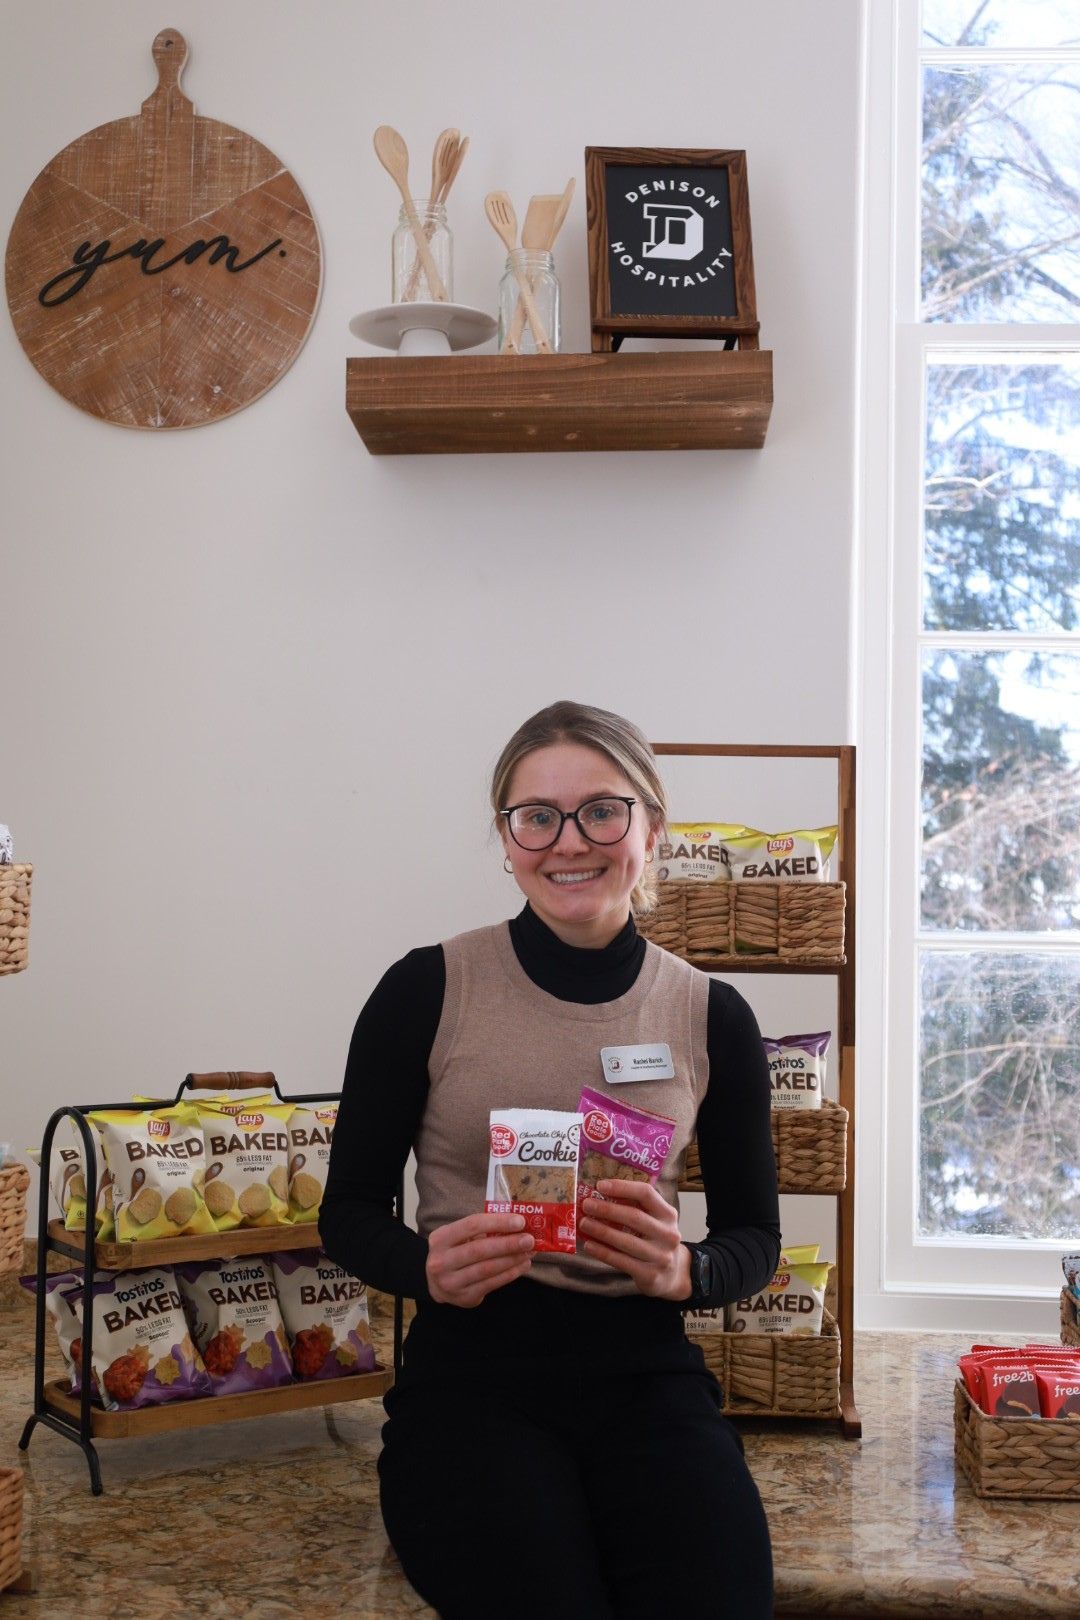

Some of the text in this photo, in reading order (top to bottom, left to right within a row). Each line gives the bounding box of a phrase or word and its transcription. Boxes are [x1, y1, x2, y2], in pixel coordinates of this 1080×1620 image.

[625, 180, 720, 208] DENISON
[611, 241, 733, 287] HOSPITALITY
[742, 856, 819, 878] BAKED
[768, 1057, 805, 1071] ostitos
[770, 1072, 818, 1091] KED
[591, 1115, 609, 1128] Red
[210, 1133, 288, 1155] BAKED
[291, 1127, 333, 1146] BAK
[491, 1130, 511, 1139] Red
[519, 1130, 567, 1141] Chocolate Chip
[126, 1138, 204, 1162] BAKED
[518, 1140, 578, 1162] Cookie
[610, 1138, 660, 1171] Cookie
[487, 1203, 544, 1214] FREE FROM
[208, 1282, 280, 1305] BAKED
[301, 1281, 367, 1305] BAKED
[103, 1290, 184, 1334] BAKED
[736, 1294, 815, 1314] BAKED
[148, 1319, 163, 1330] LESS
[162, 1316, 172, 1324] FAT
[993, 1371, 1035, 1387] free2b
[1054, 1385, 1080, 1398] free
